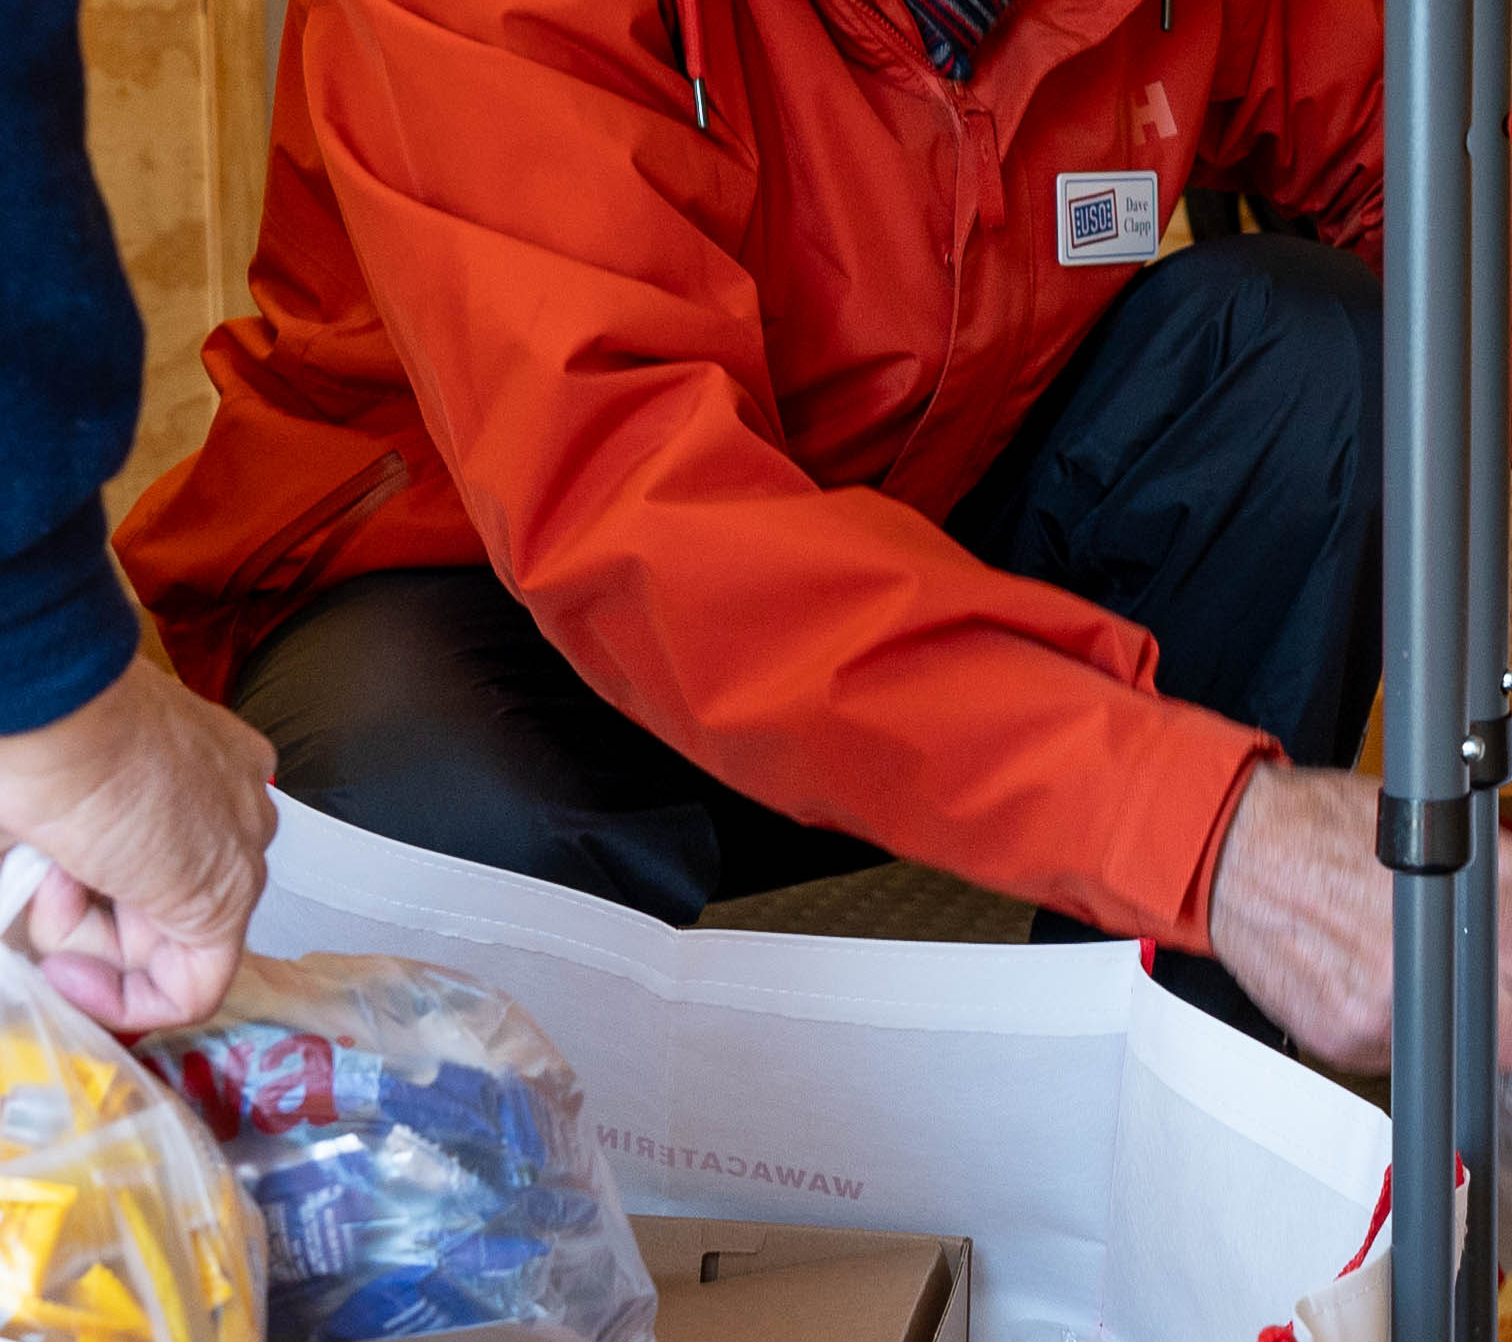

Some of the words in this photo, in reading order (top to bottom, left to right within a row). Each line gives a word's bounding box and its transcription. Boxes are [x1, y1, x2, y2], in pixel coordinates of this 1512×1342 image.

[1126, 198, 1148, 212] Dave
[1080, 202, 1107, 234] USO
[1124, 219, 1151, 237] Clapp
